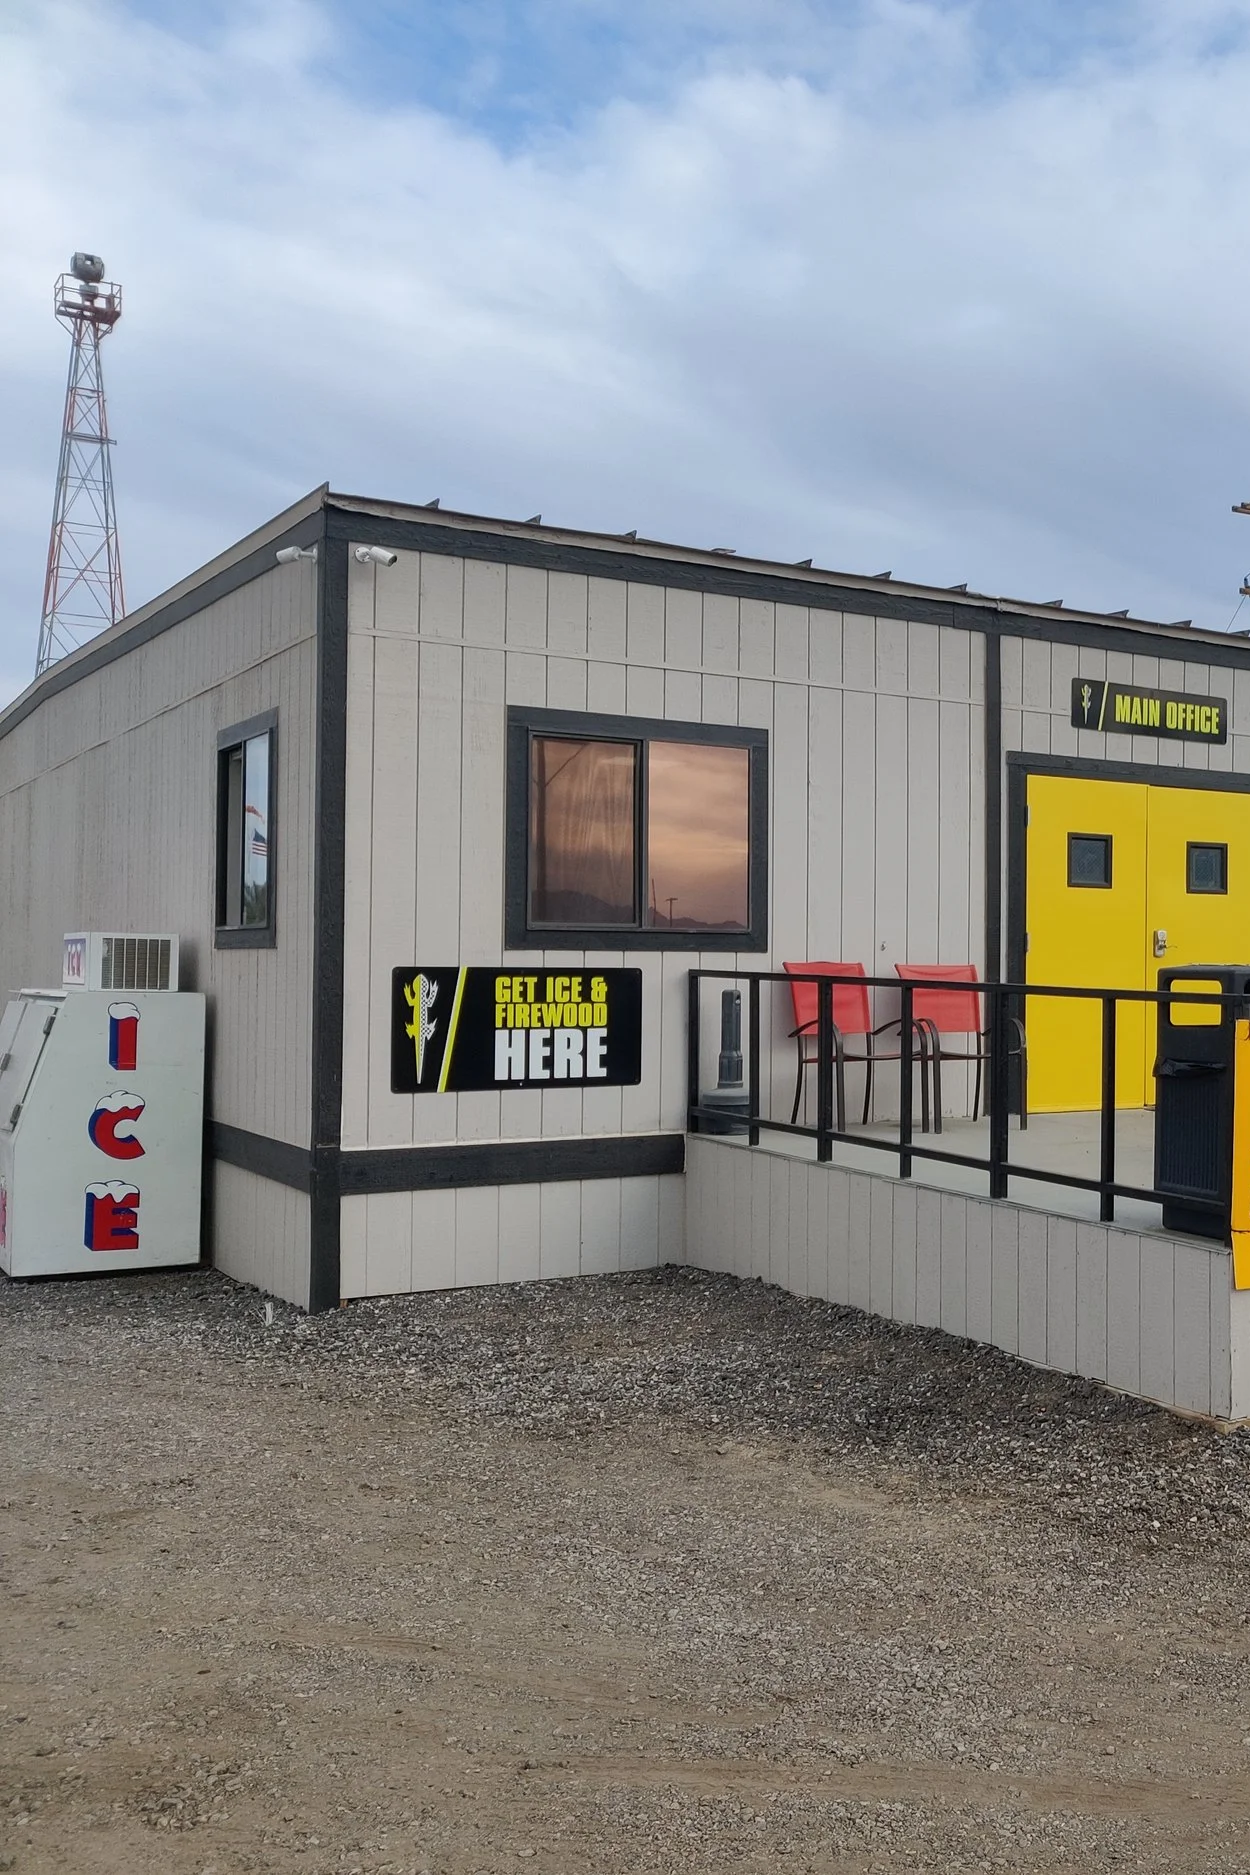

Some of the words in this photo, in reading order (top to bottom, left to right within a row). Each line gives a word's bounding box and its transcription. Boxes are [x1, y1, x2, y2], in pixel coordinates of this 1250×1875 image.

[1115, 694, 1160, 728] MAIN
[1165, 701, 1220, 735] OFFICE
[495, 976, 538, 1003] GET
[546, 976, 582, 1003] ICE
[590, 976, 608, 1003] &
[495, 1003, 608, 1028] FIREWOOD
[494, 1028, 608, 1081] HERE
[84, 1002, 146, 1251] ICE
